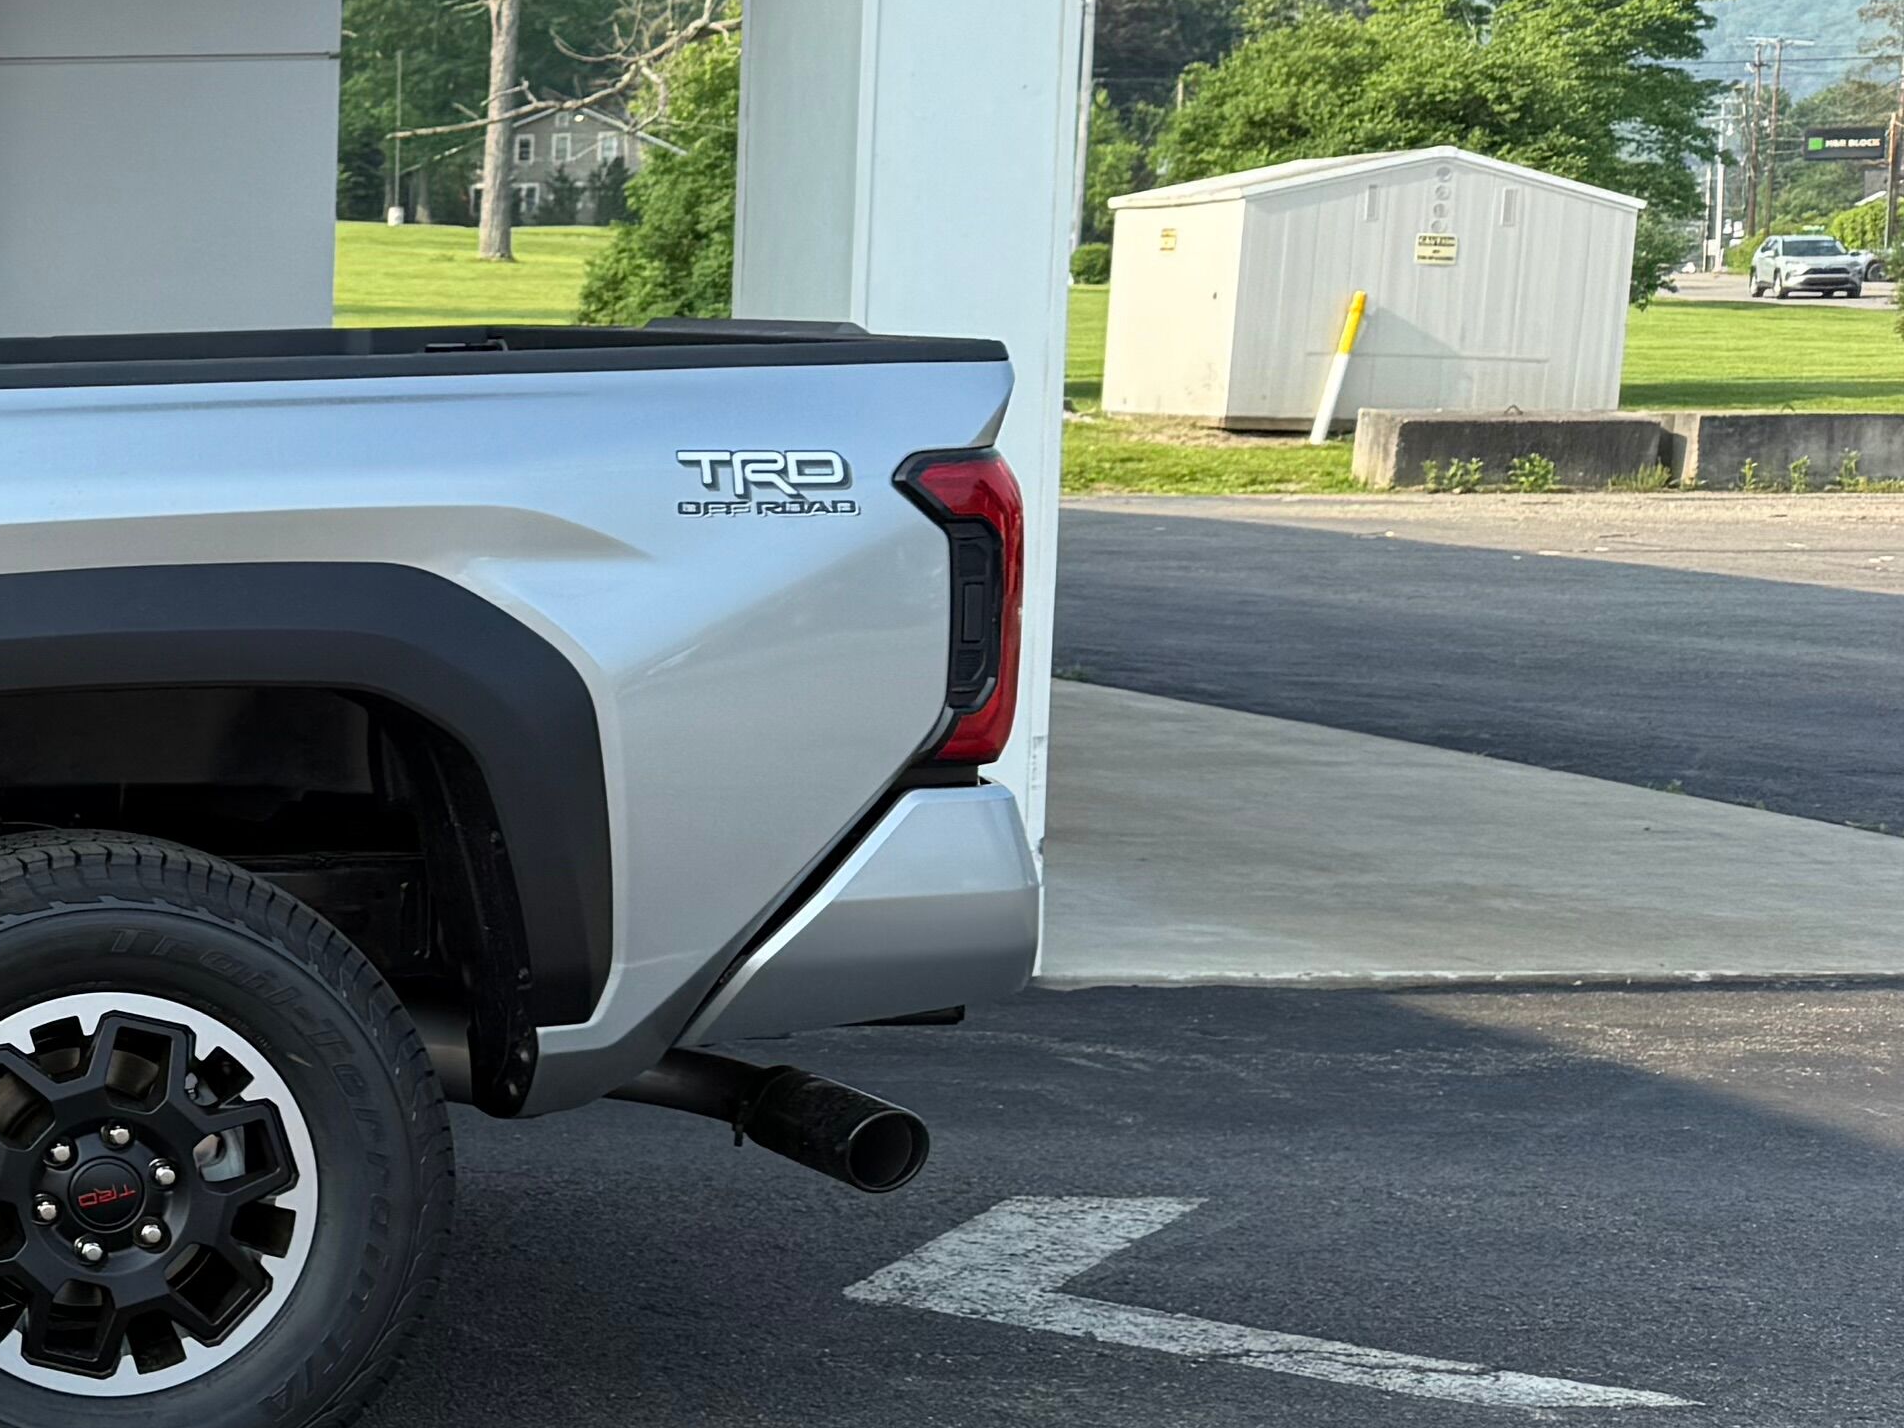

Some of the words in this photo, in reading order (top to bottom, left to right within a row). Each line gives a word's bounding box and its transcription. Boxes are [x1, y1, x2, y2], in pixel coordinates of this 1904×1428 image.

[1848, 138, 1880, 147] BLOCK
[676, 450, 848, 496] TRD
[678, 500, 751, 517] OFF
[756, 500, 860, 516] ROAD
[78, 1183, 137, 1209] TRD
